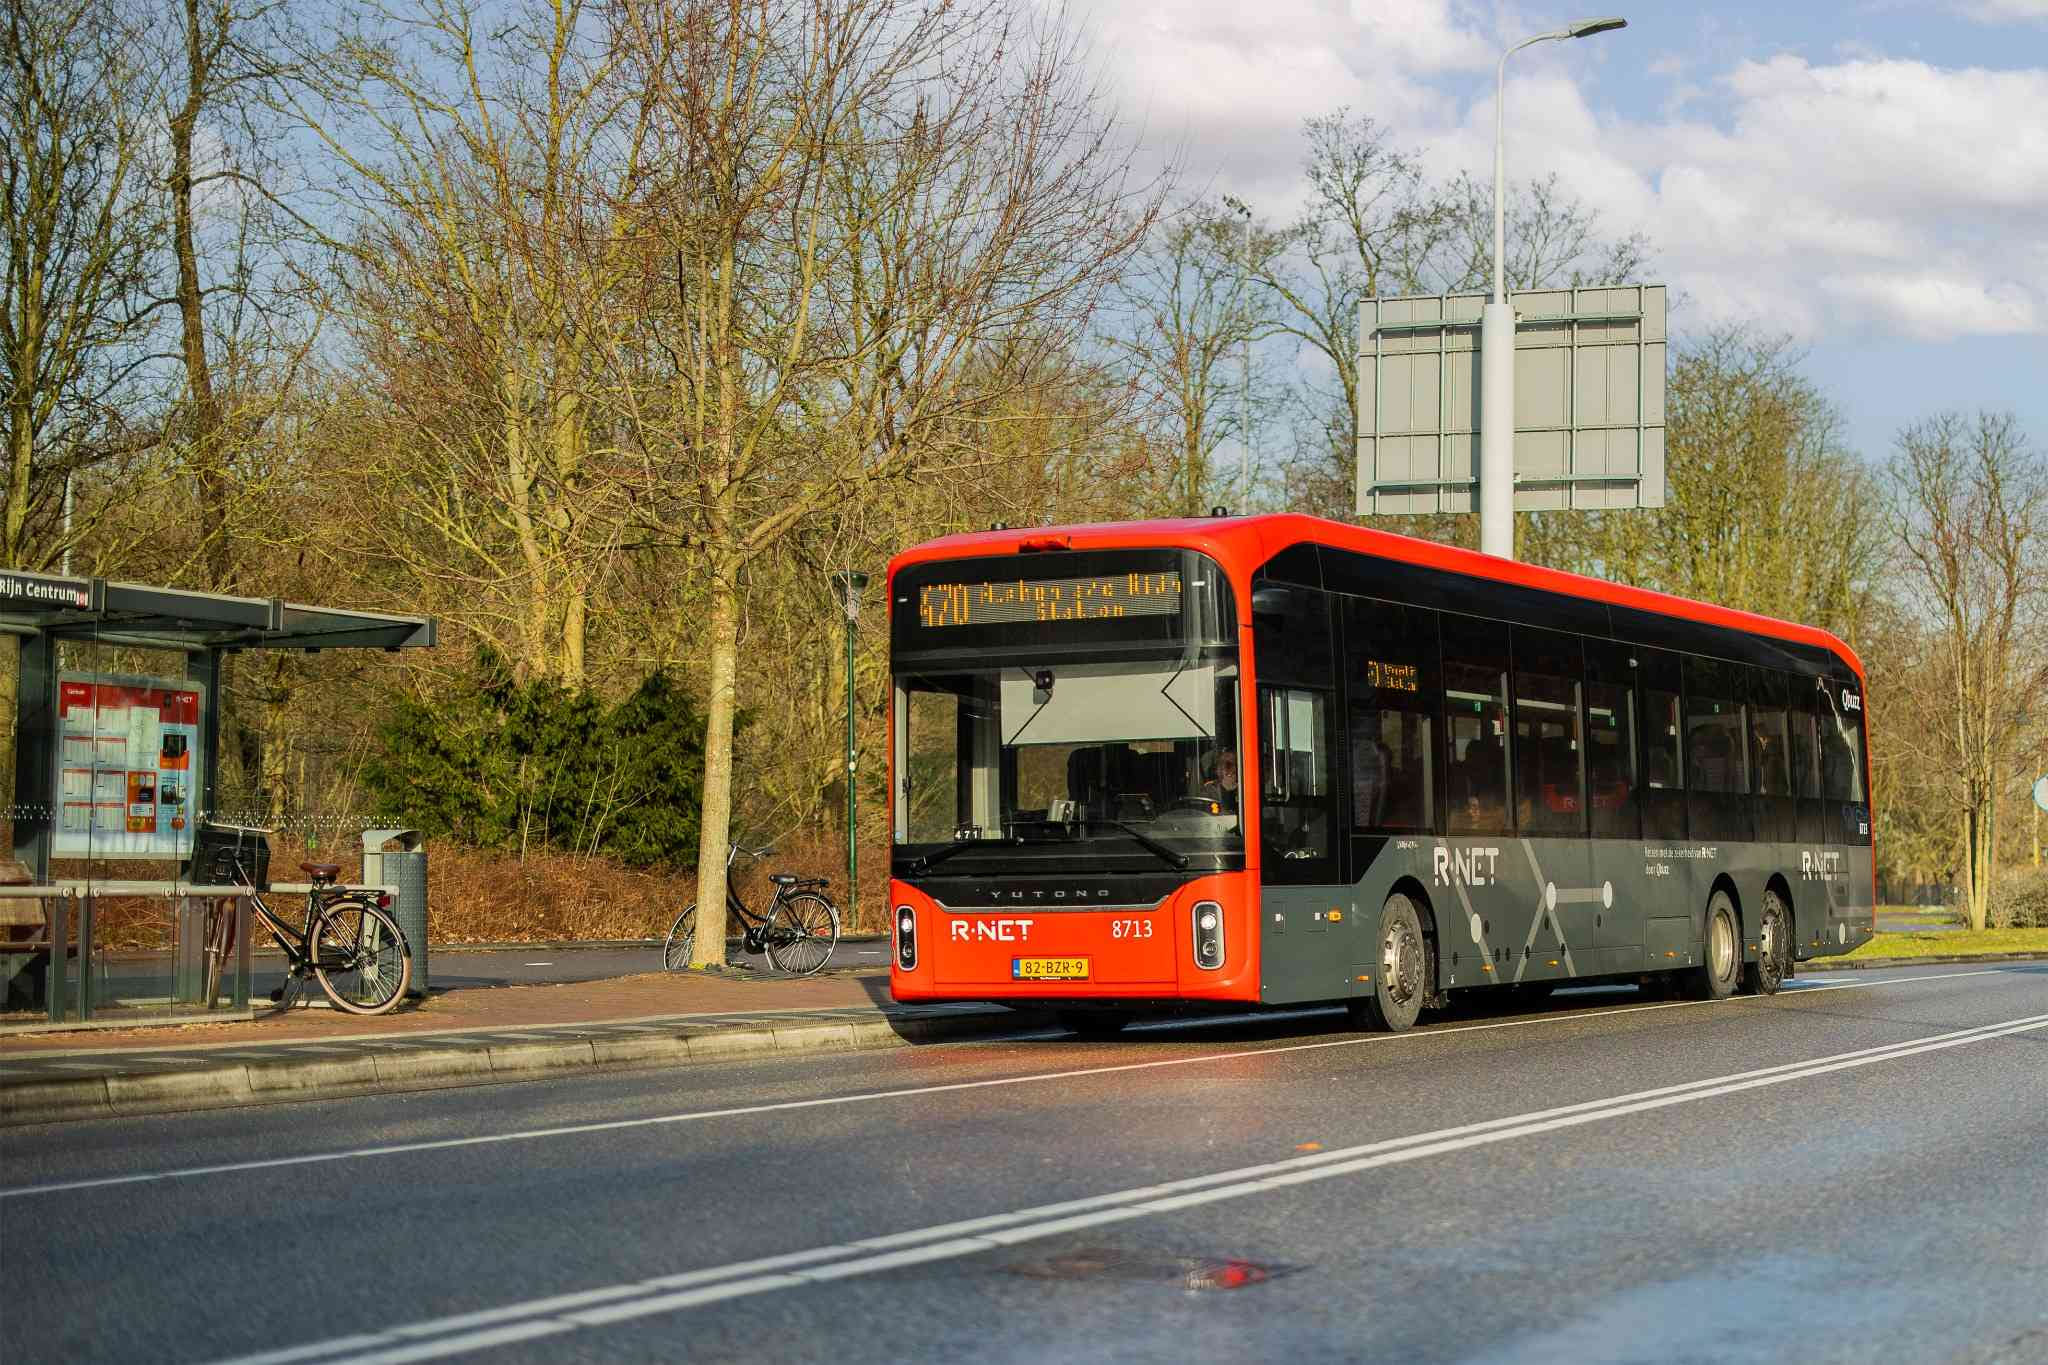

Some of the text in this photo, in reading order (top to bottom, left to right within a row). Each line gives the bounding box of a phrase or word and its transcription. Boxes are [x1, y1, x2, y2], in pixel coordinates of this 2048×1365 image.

[26, 581, 77, 602] Centrum
[954, 830, 978, 840] 471
[991, 889, 1110, 899] YUTONG
[1112, 919, 1153, 939] 8713
[1024, 961, 1084, 975] 82-BZR-9
